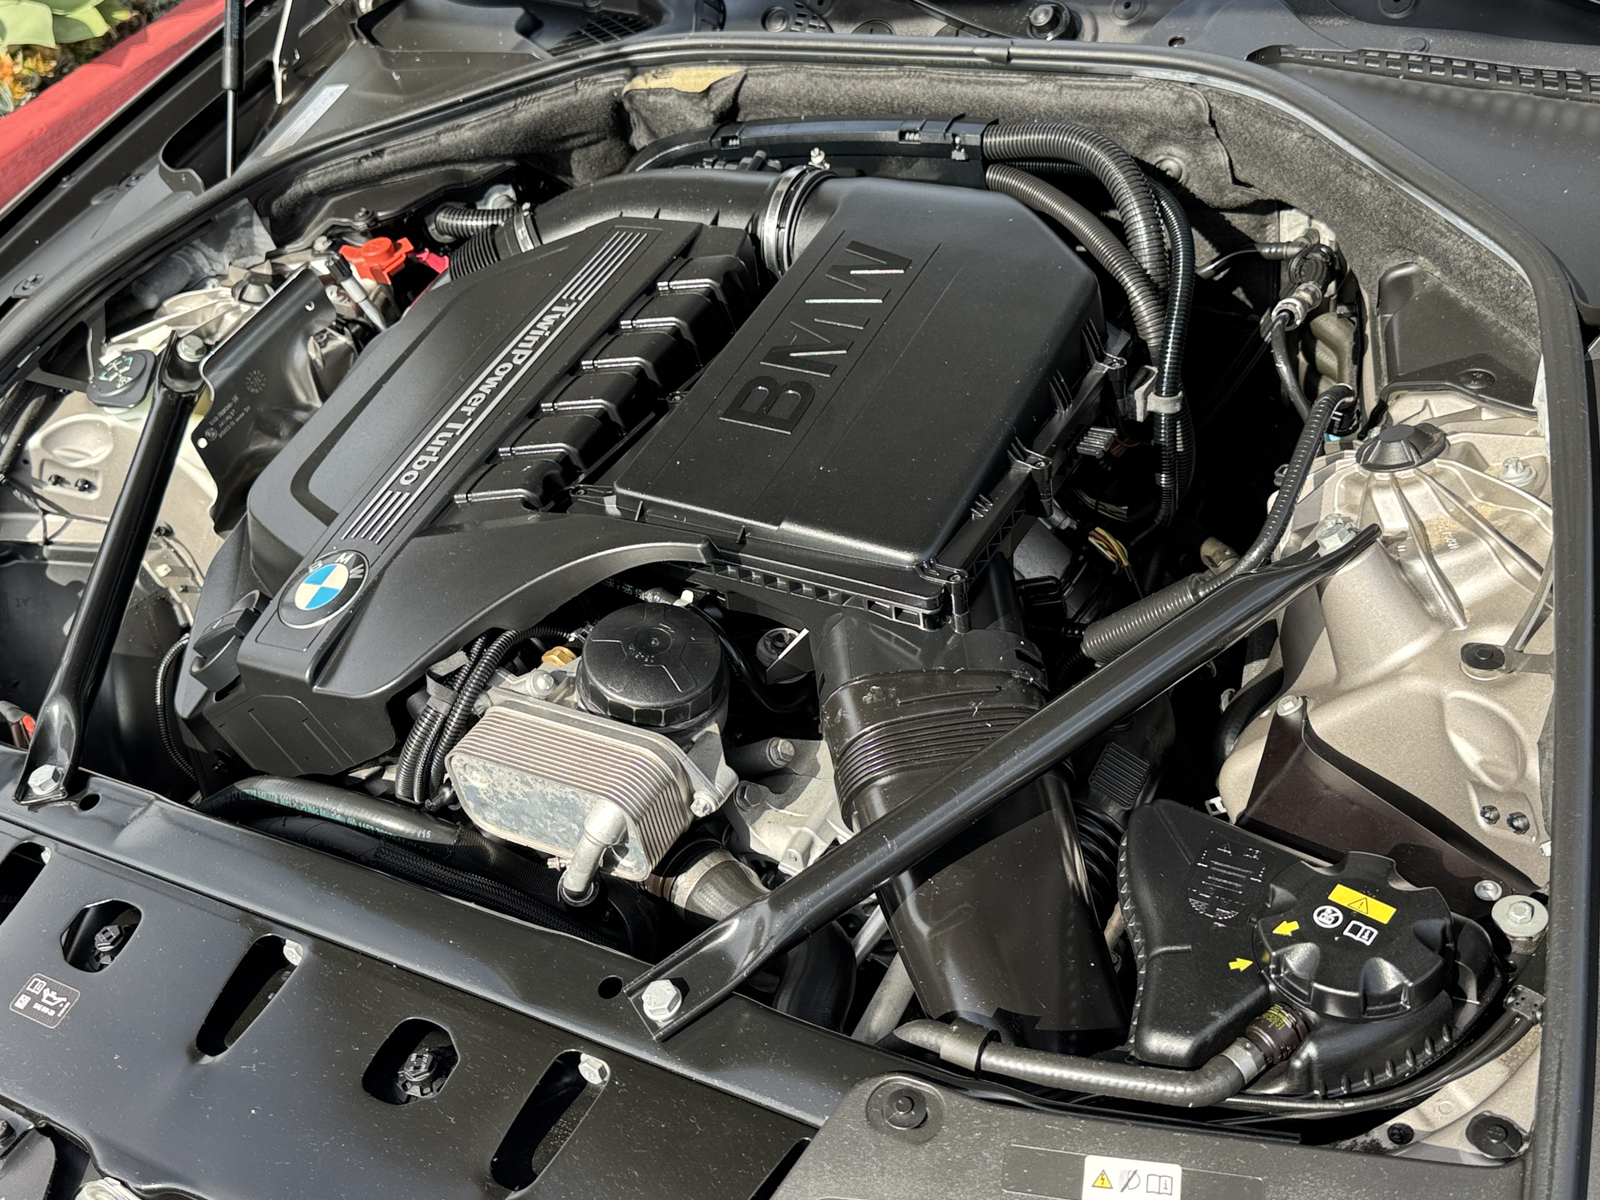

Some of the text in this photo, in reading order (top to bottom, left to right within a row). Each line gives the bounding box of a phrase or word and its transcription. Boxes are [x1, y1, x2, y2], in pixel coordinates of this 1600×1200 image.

[399, 301, 577, 486] TwinPower Turbo
[719, 239, 912, 434] BMW
